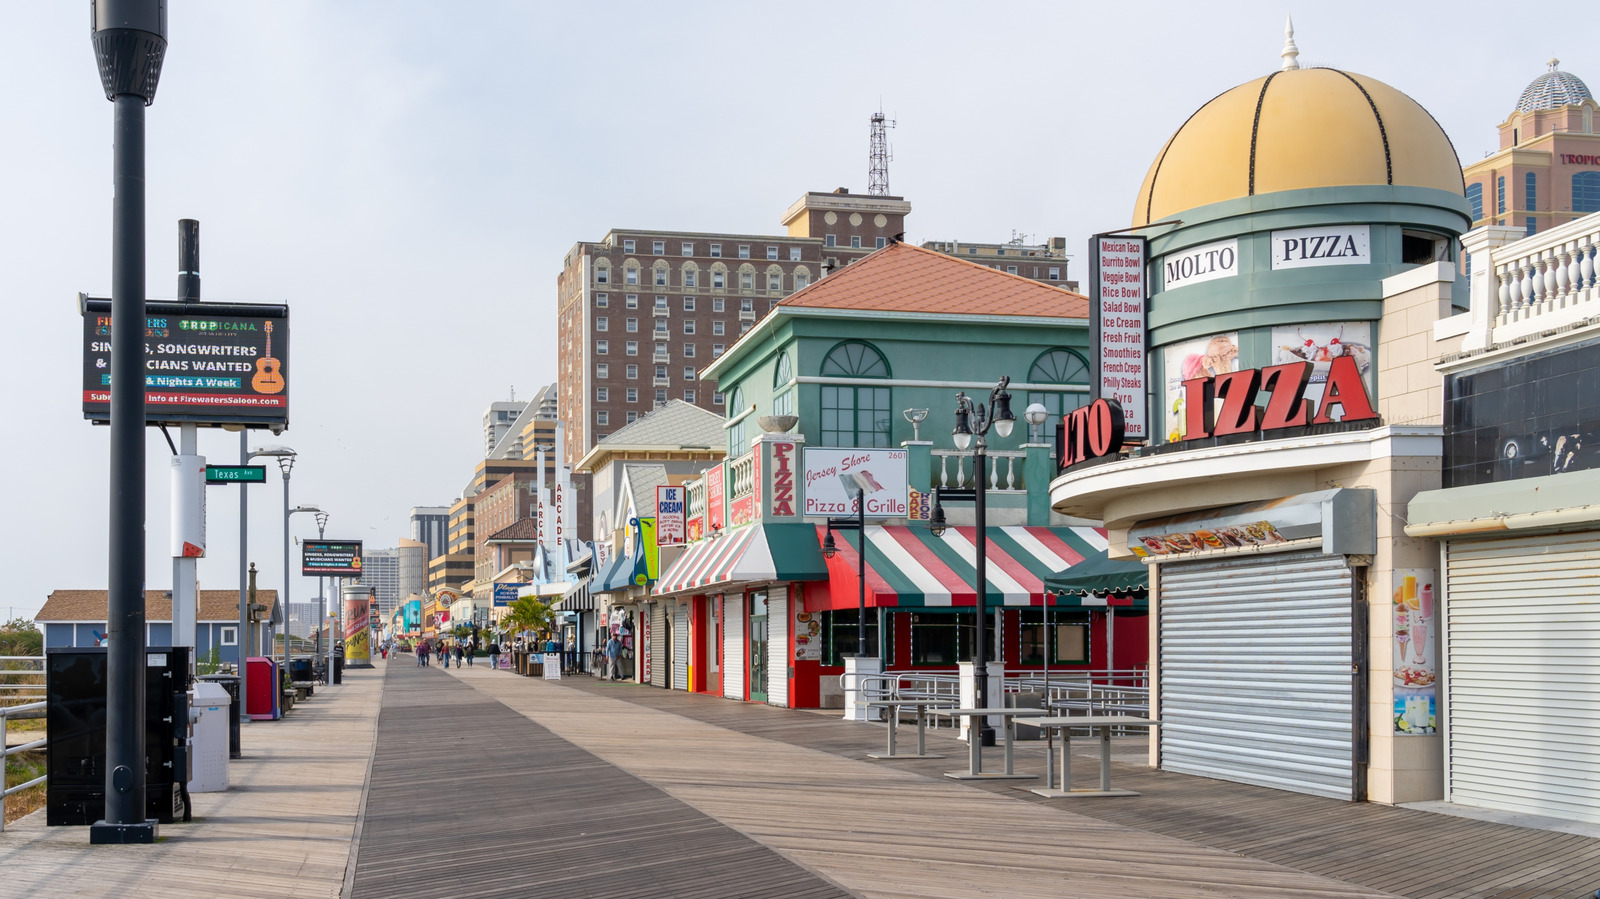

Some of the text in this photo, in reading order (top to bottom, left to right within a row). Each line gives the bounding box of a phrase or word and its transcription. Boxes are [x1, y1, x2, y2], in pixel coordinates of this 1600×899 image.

[1102, 241, 1140, 253] Mexican Taco
[1282, 234, 1360, 261] PIZZA
[1102, 256, 1140, 268] Burrito Bowl
[1166, 247, 1234, 284] MOLTO
[1102, 272, 1140, 284] Veggie Bowl
[1102, 286, 1140, 298] Rice Bowl
[1103, 302, 1141, 313] Salad Bowl
[182, 320, 257, 331] TROPICANA
[1103, 316, 1141, 328] Ice Cream
[1104, 332, 1141, 344] Fresh Fruit
[92, 342, 256, 356] SINS, SONGWRITERS
[1104, 347, 1141, 358] Smoothies
[96, 358, 252, 372] & CIANS WANTED
[1104, 362, 1142, 375] French Crepe
[157, 378, 192, 388] Nights
[206, 379, 237, 387] Week
[1104, 377, 1142, 390] Philly Steaks
[180, 396, 279, 405] FirewatersSaloon.com
[1113, 392, 1132, 404] Gyro
[1060, 398, 1113, 469] LTO
[1125, 422, 1142, 433] More
[888, 452, 906, 460] 2601
[214, 469, 238, 479] Texas
[806, 454, 872, 487] Jersey Shore
[772, 442, 795, 516] PIZZA
[666, 488, 676, 500] ICE
[660, 502, 682, 514] CREAM
[806, 498, 906, 513] Pizza & Grille
[909, 491, 920, 520] CAKE
[920, 493, 930, 520] REOS
